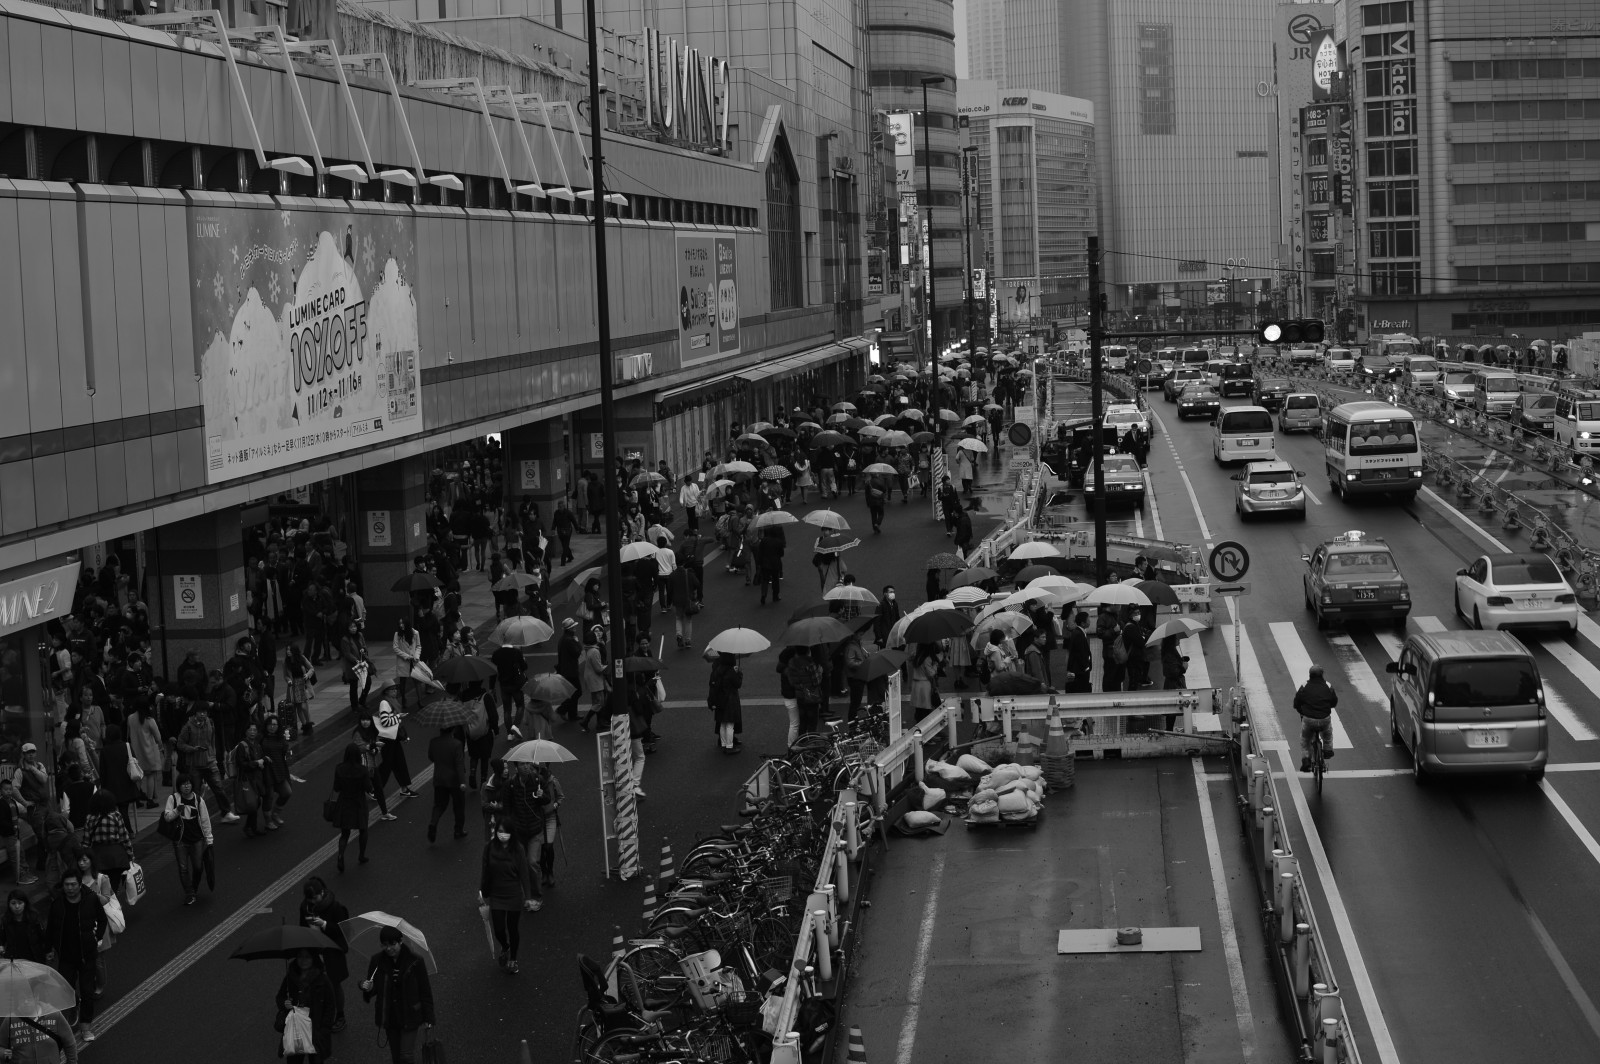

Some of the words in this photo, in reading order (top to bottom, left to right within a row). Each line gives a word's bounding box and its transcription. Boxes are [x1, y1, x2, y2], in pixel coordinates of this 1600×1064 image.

[1288, 47, 1312, 60] JR
[1391, 33, 1409, 132] Victoria
[1002, 97, 1028, 106] KEIO
[196, 223, 220, 237] LUMINE
[1006, 281, 1031, 289] FOREVER
[289, 297, 322, 328] LUMINE
[322, 287, 346, 314] CARD
[690, 288, 707, 310] Suica
[291, 301, 366, 393] 10%OFF
[44, 580, 59, 614] 2
